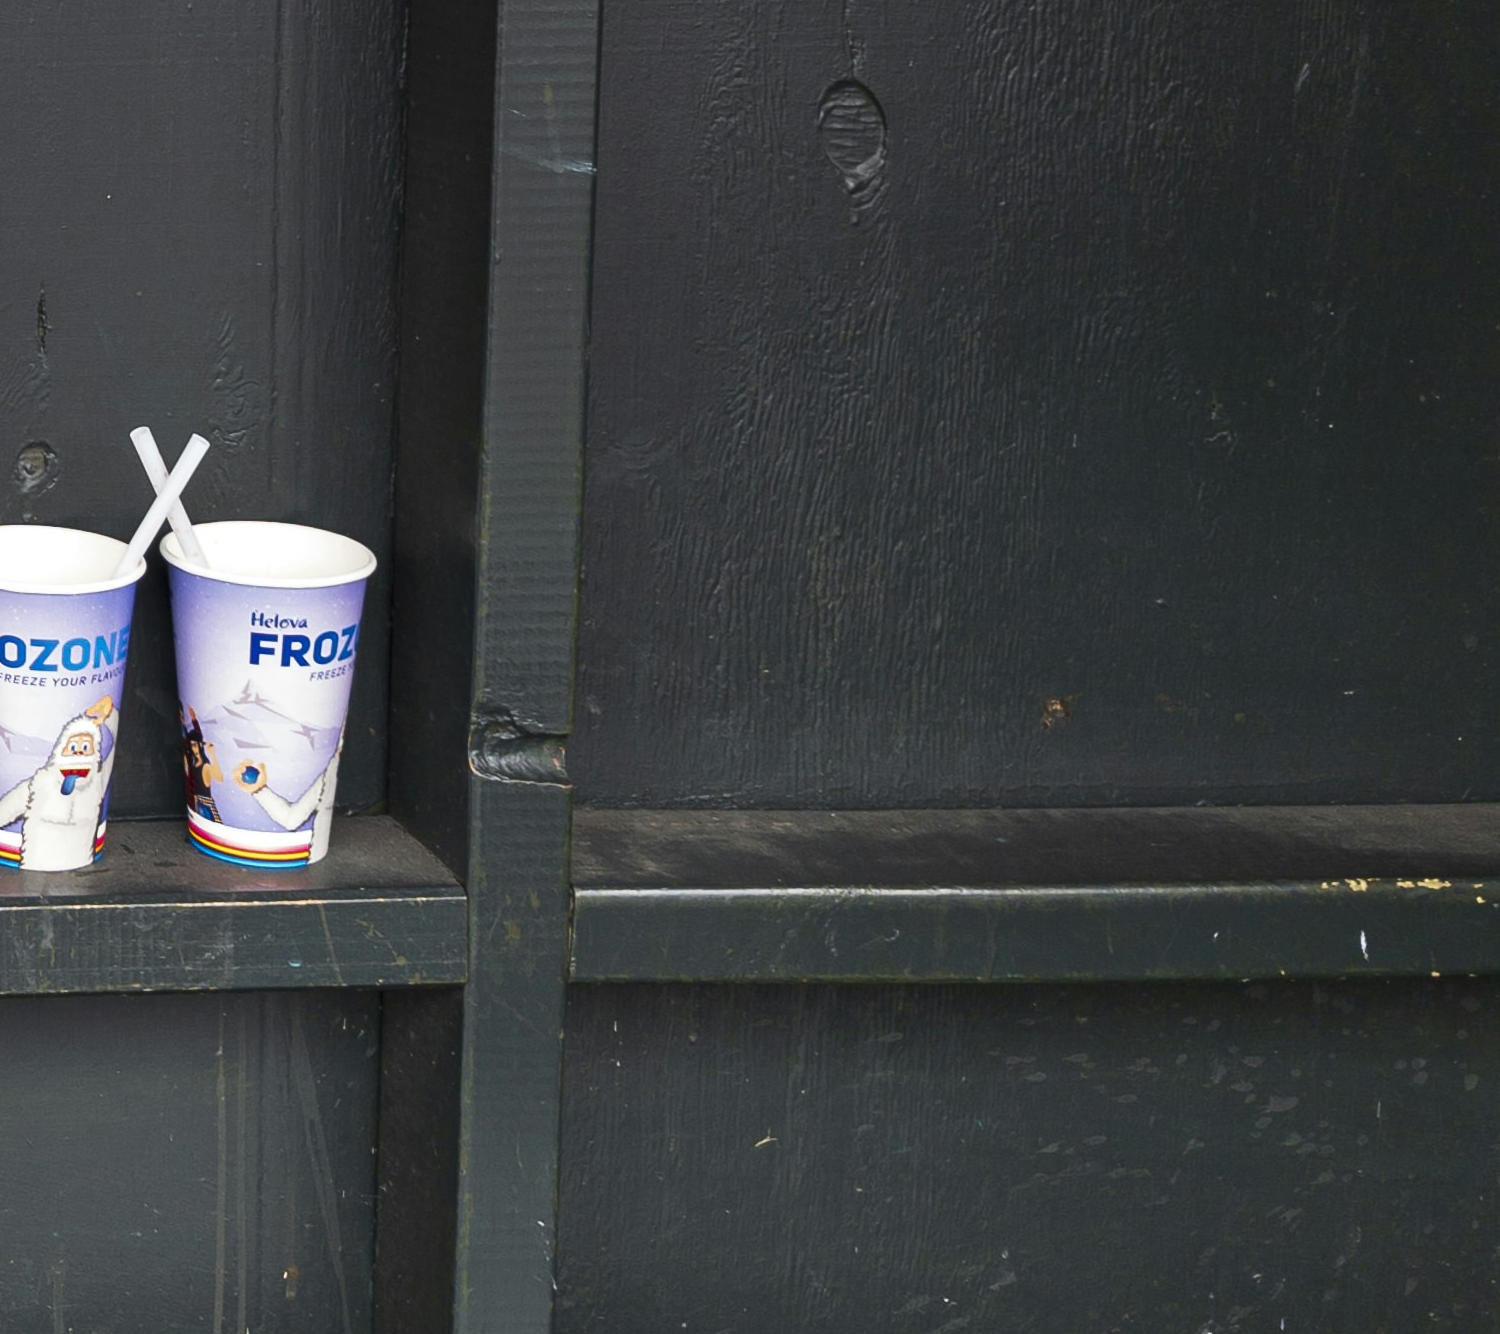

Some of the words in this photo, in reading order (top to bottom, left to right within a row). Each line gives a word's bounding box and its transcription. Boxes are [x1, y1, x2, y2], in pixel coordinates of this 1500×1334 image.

[251, 610, 308, 629] Helova
[250, 624, 360, 667] FROZ
[53, 677, 87, 687] YOUR
[310, 665, 346, 682] FREEZE
